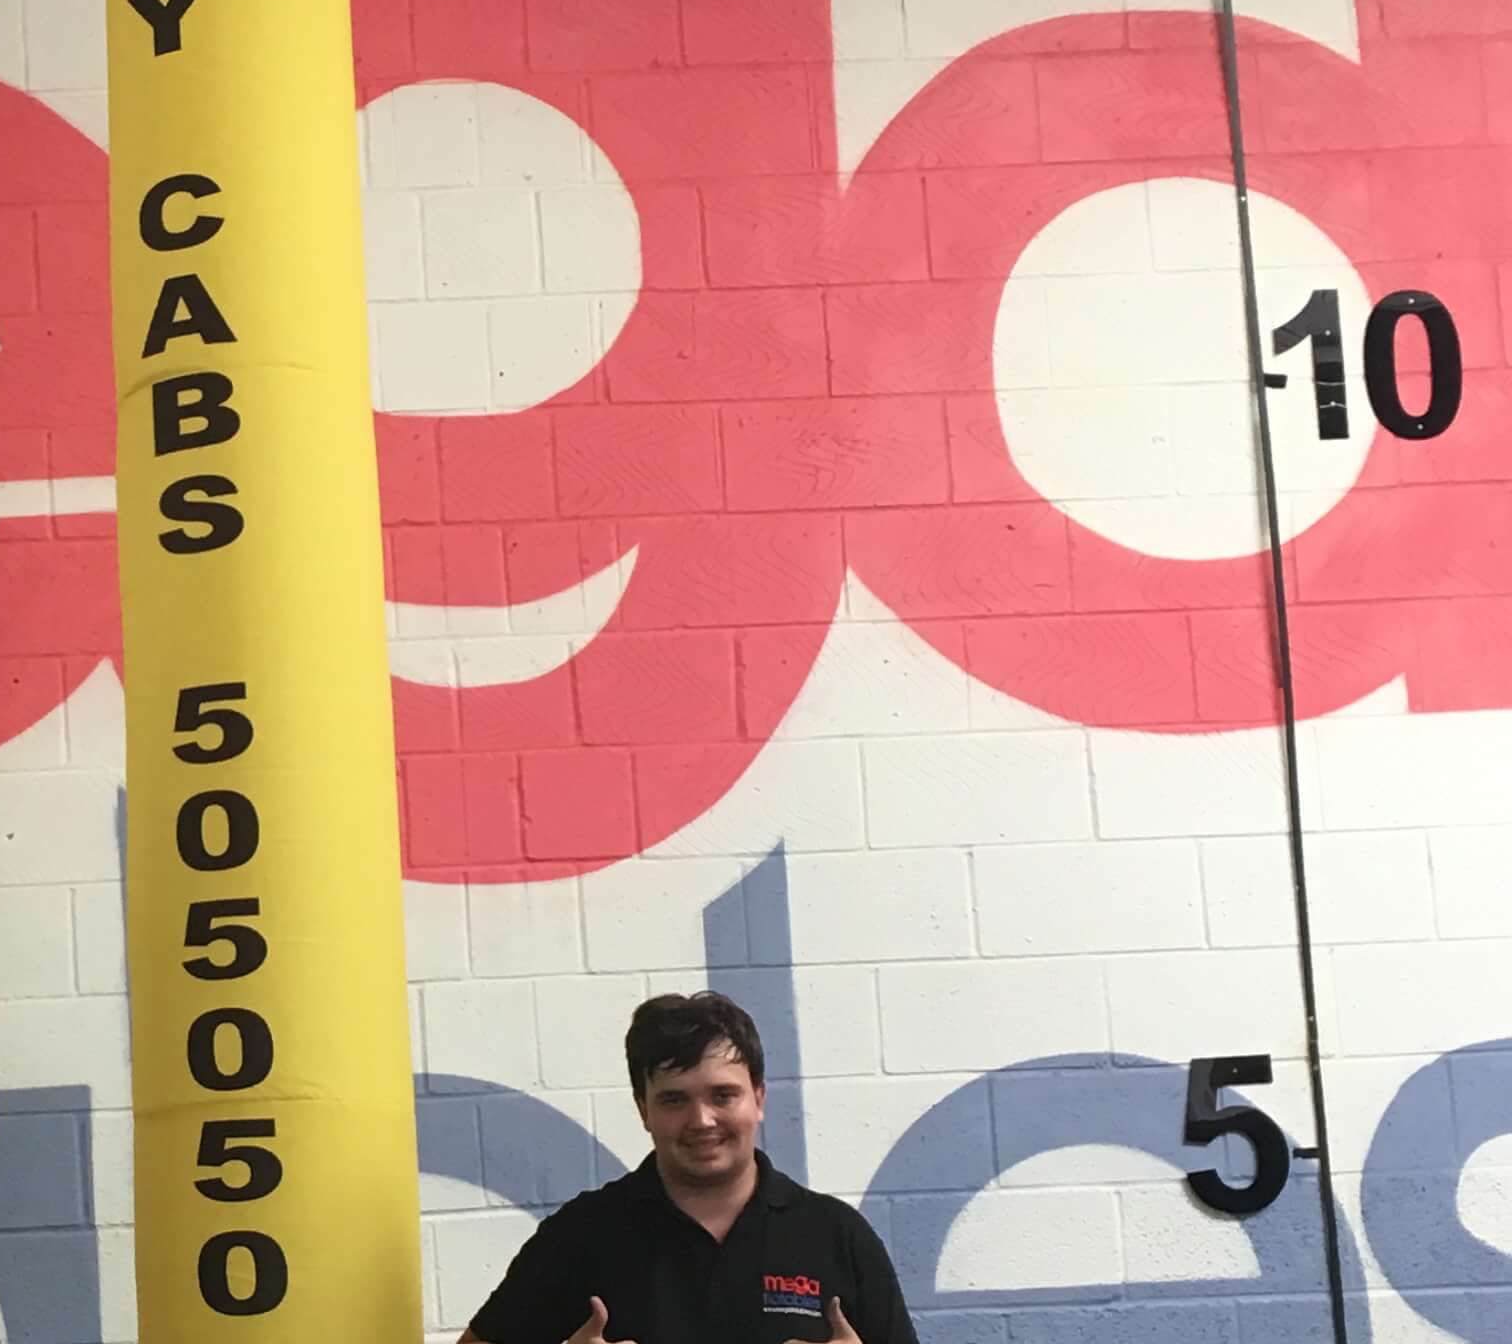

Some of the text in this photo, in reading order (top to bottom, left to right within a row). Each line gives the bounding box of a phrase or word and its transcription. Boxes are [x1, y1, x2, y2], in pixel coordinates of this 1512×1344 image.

[138, 173, 246, 555] CABS
[1272, 288, 1463, 441] 10
[172, 681, 288, 1318] 505050
[1182, 1053, 1292, 1216] 5
[763, 1275, 821, 1296] mega
